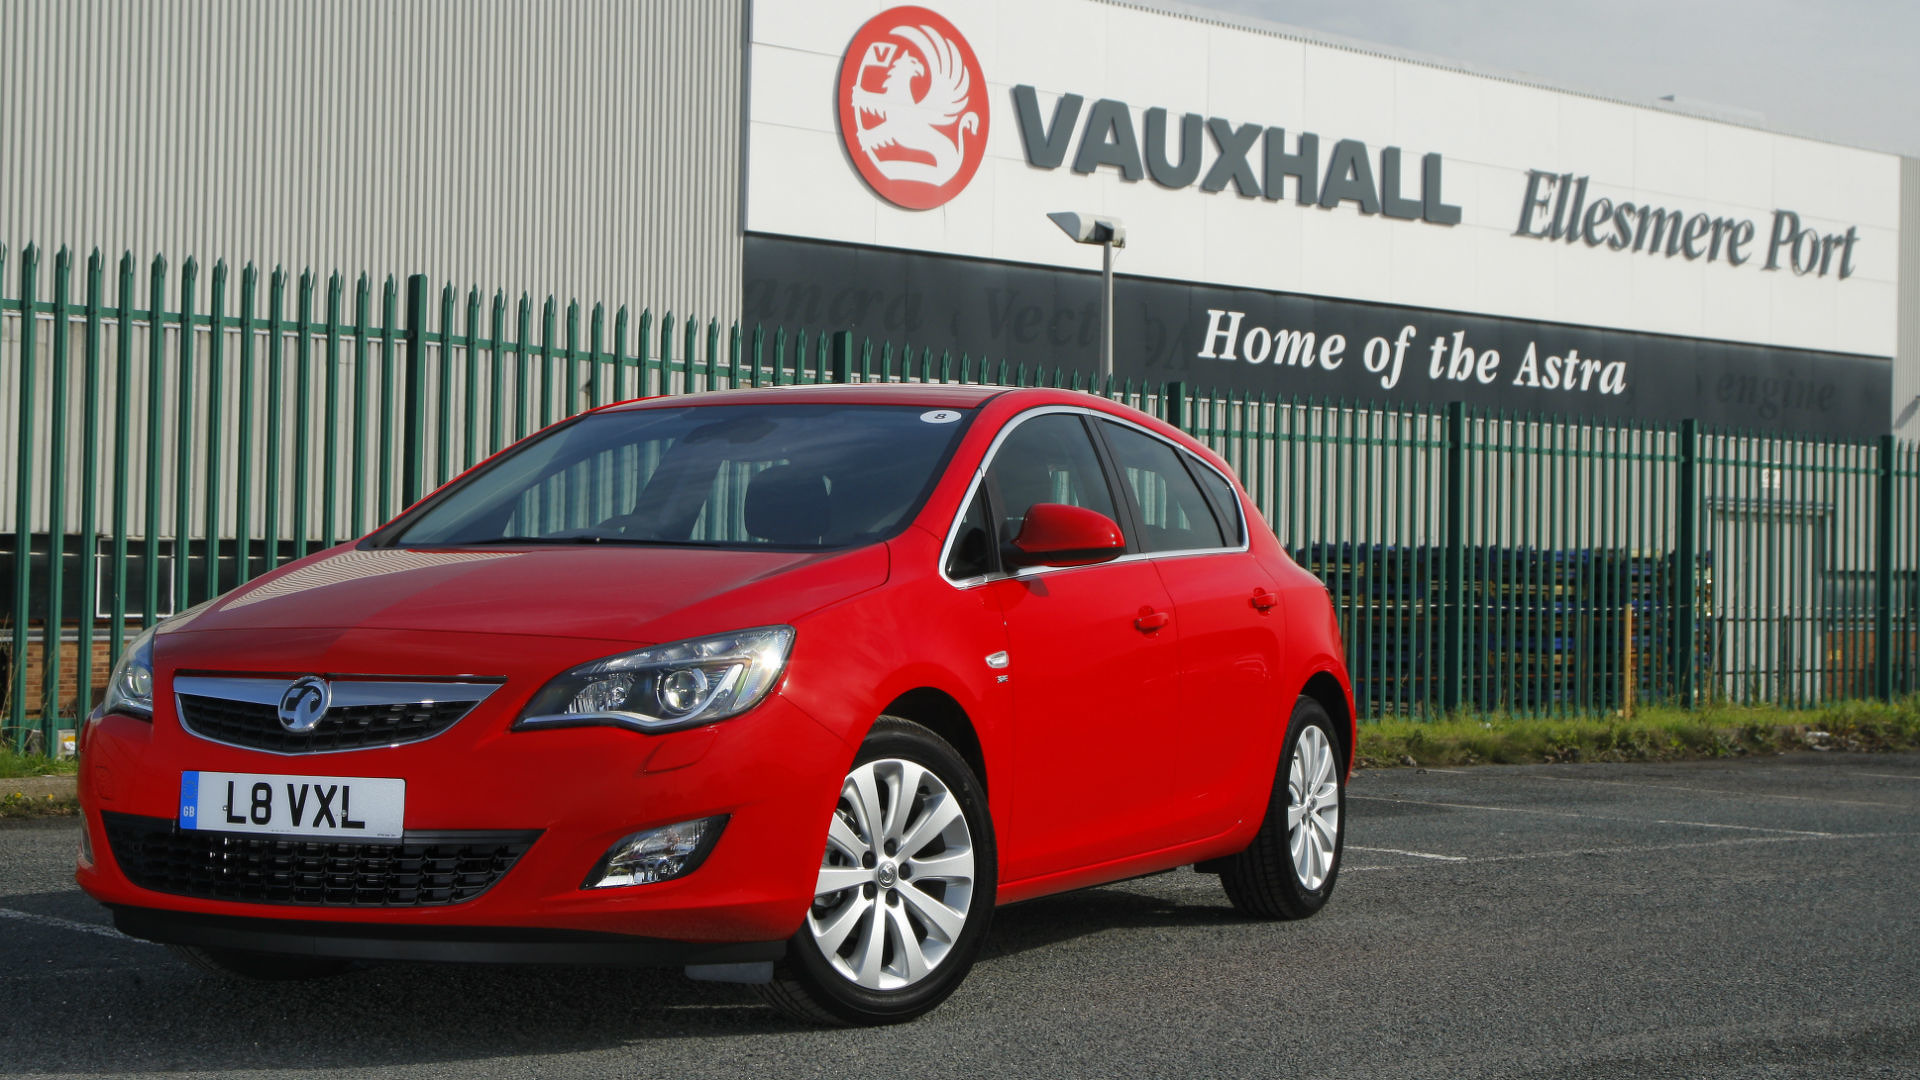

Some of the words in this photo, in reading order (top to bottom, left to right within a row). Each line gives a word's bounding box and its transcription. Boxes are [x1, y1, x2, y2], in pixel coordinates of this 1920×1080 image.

[873, 45, 891, 62] V
[1010, 84, 1462, 226] VAUXHALL
[1510, 168, 1755, 267] Ellesmere
[1761, 208, 1860, 281] Port
[1197, 309, 1347, 371] Home
[1363, 325, 1417, 390] of
[1429, 330, 1500, 384] the
[1512, 341, 1627, 395] Astra
[1716, 368, 1837, 421] engine
[183, 805, 196, 818] GB
[226, 780, 273, 826] L8
[287, 783, 366, 829] VXL
